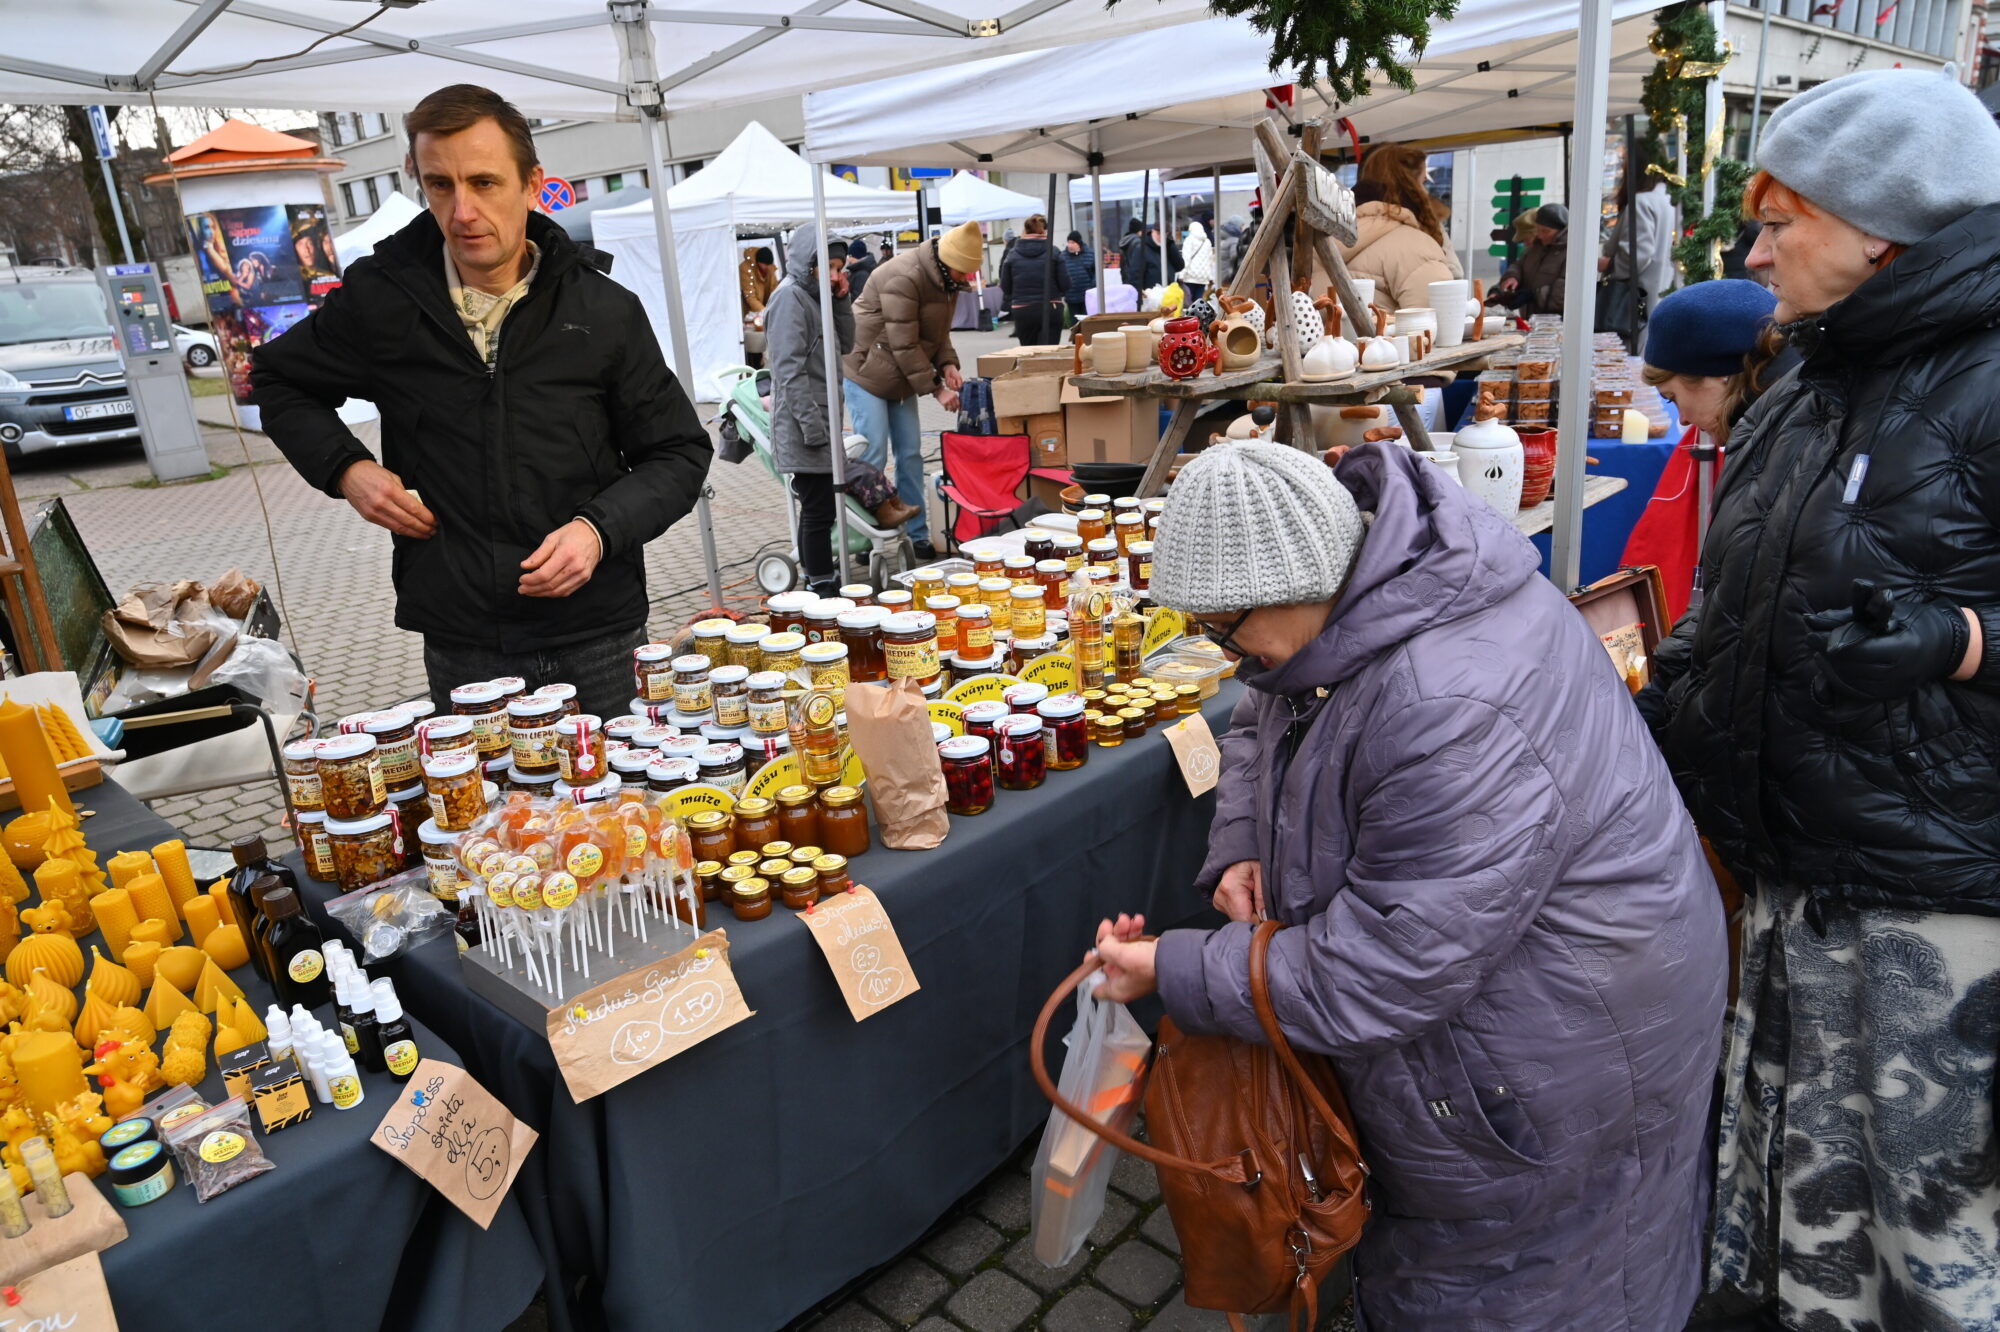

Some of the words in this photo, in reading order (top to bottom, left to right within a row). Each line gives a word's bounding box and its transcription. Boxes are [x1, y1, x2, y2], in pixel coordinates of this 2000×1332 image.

[887, 649, 916, 657] MEDUS
[1023, 663, 1046, 682] iepu
[379, 744, 409, 756] RIEKSTI
[382, 763, 413, 775] MEDUS
[752, 768, 778, 797] Bišu
[680, 792, 721, 807] maize
